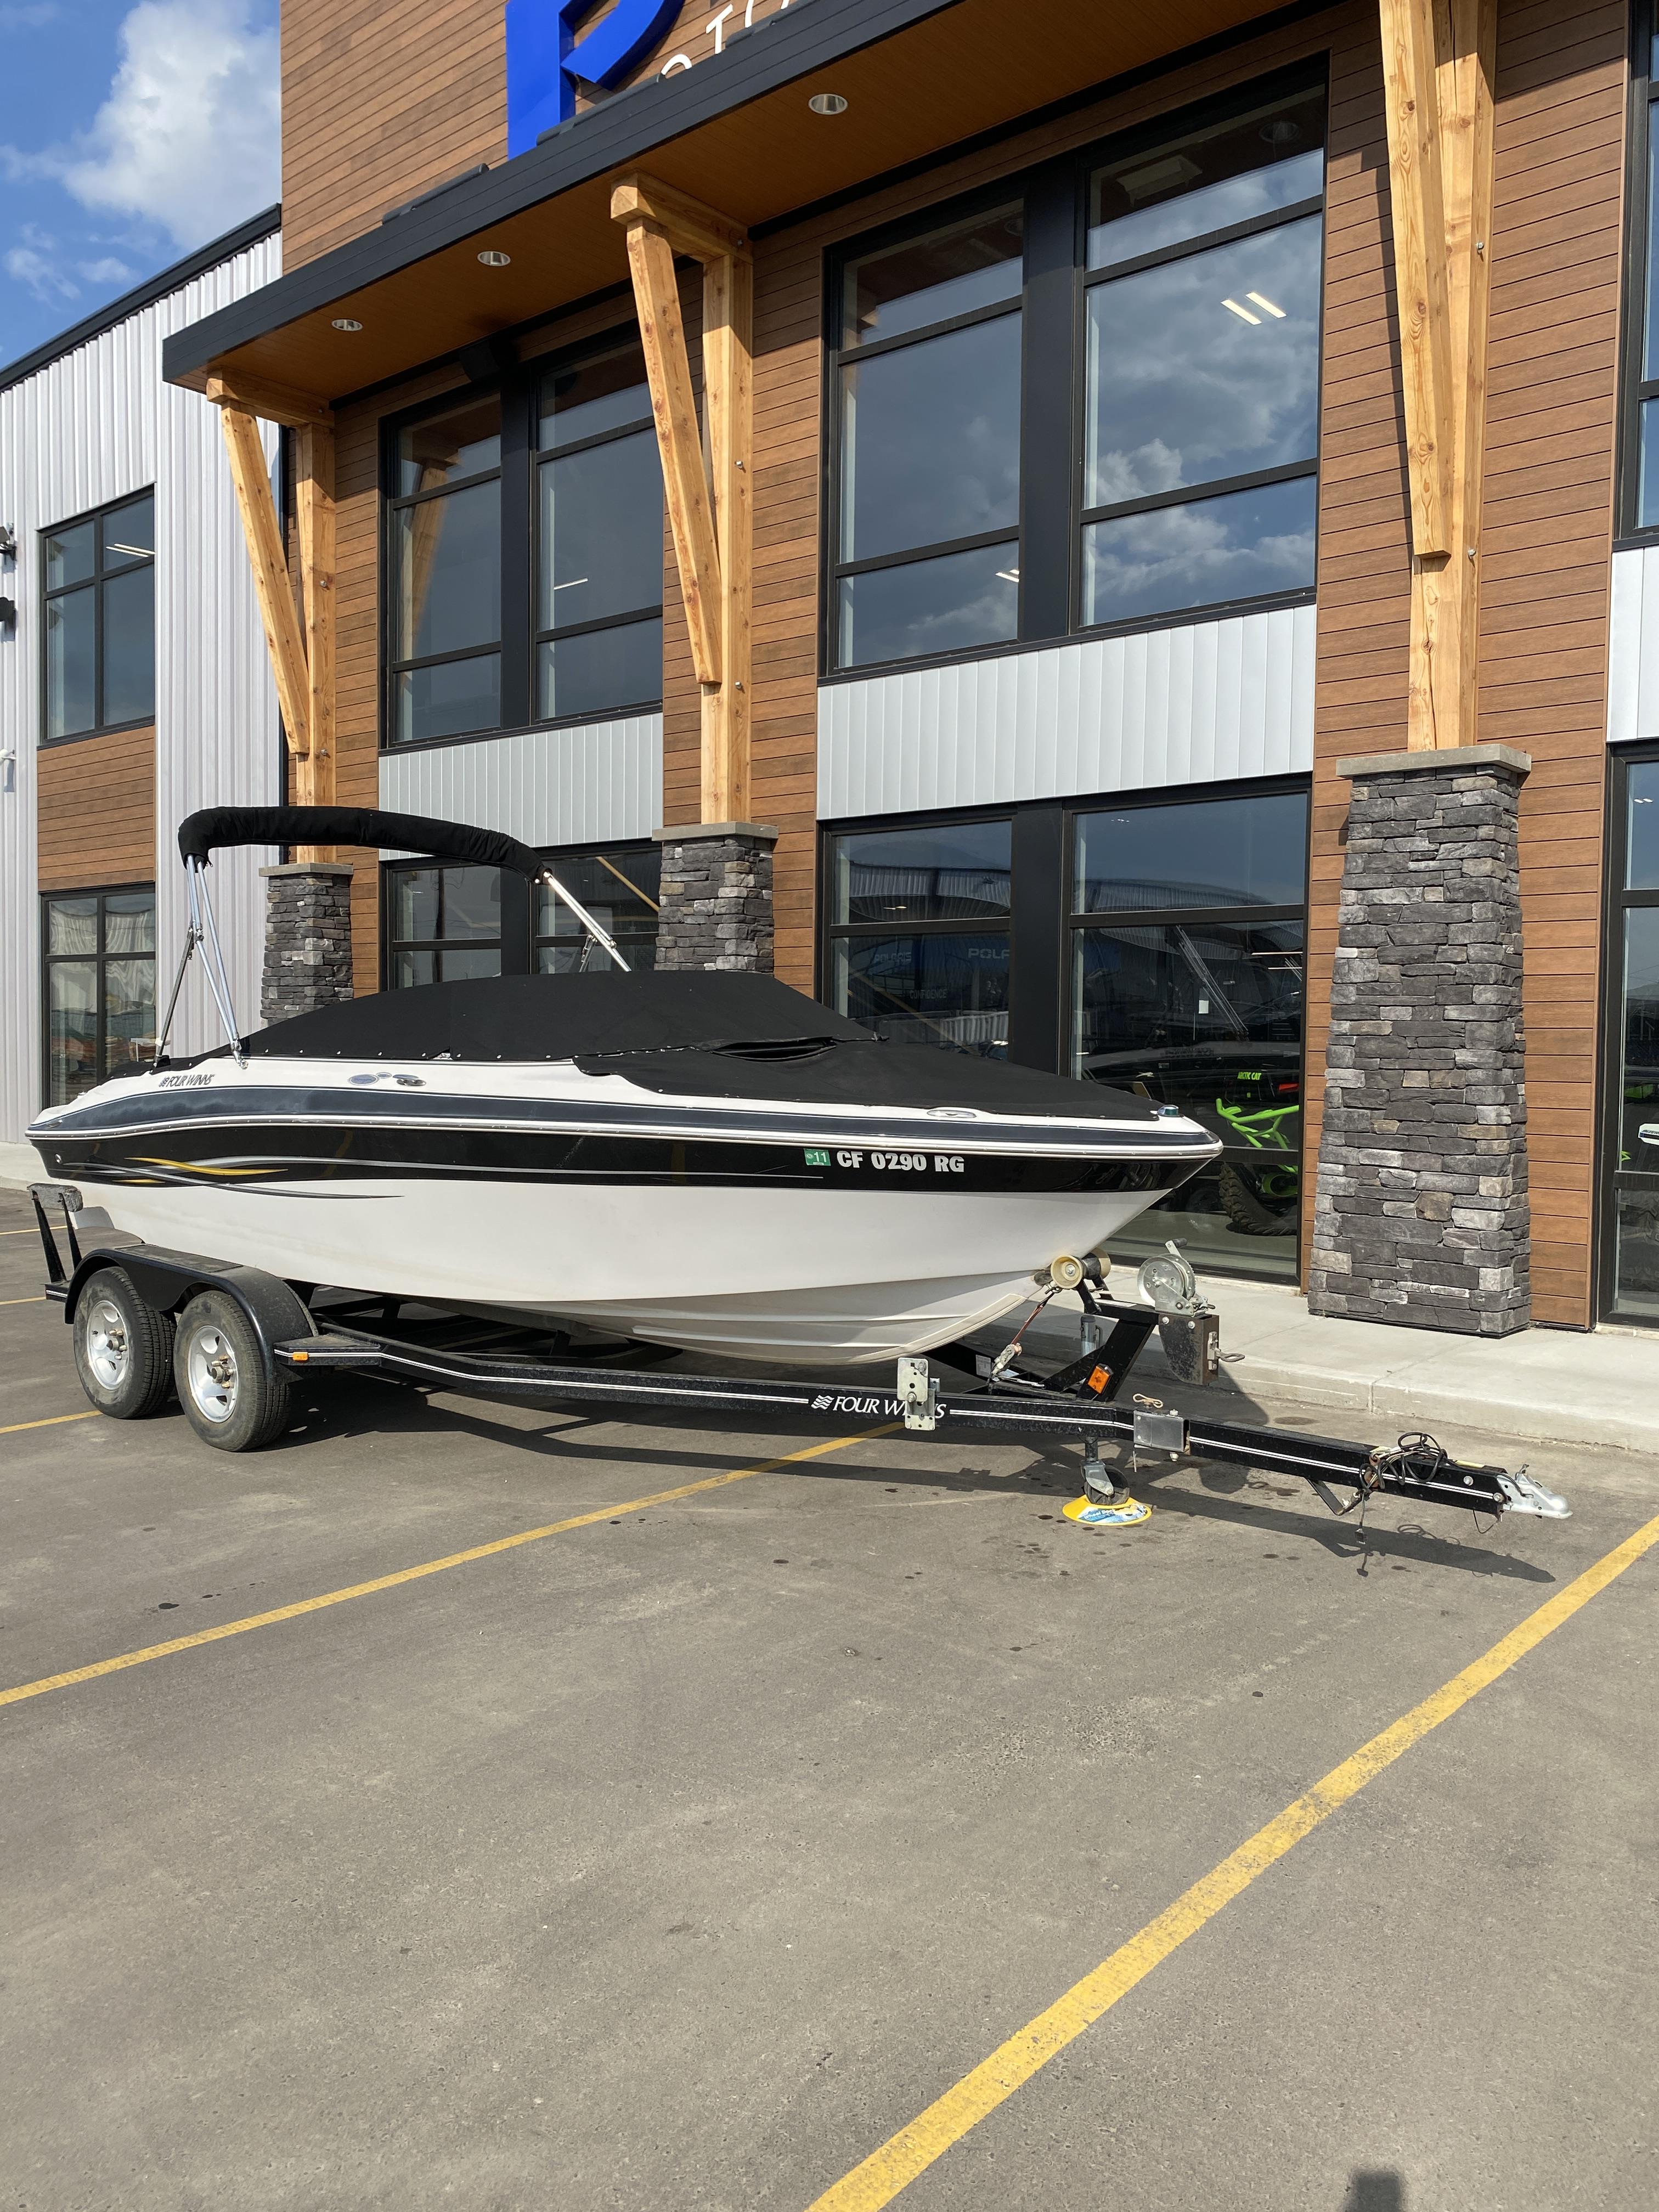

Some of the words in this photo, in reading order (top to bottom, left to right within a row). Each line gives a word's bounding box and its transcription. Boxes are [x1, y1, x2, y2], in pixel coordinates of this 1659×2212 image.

[1251, 1072, 1262, 1080] CAT
[814, 1152, 827, 1163] 11
[837, 1150, 864, 1168] CF
[871, 1152, 927, 1171] 0290
[934, 1155, 964, 1172] RG
[833, 1396, 879, 1414] FOUR
